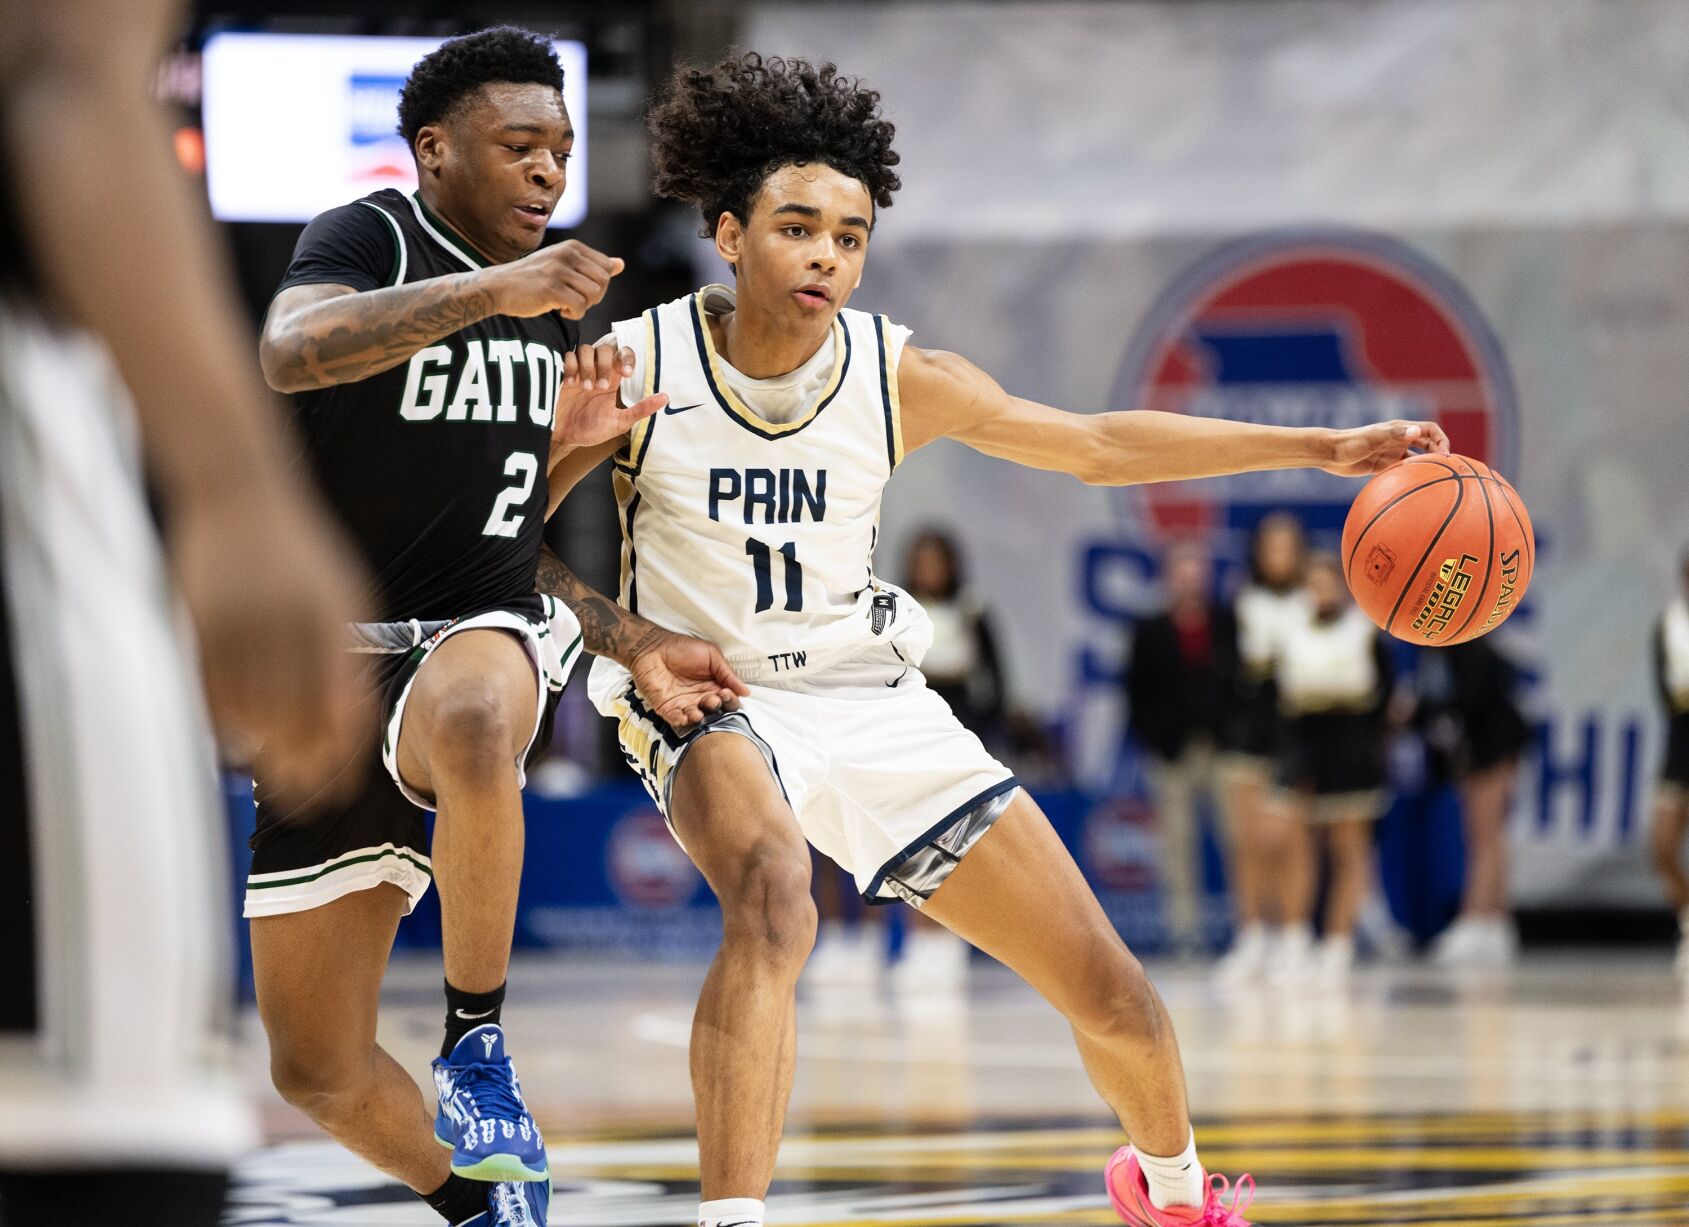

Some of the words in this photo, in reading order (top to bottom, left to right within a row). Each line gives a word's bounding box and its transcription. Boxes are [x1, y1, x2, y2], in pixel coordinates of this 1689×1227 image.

[482, 451, 539, 538] 2
[708, 468, 827, 525] PRIN
[745, 537, 803, 614] 11
[1411, 581, 1446, 631] 1000
[1422, 553, 1479, 639] LEGACY
[767, 650, 807, 672] TTW
